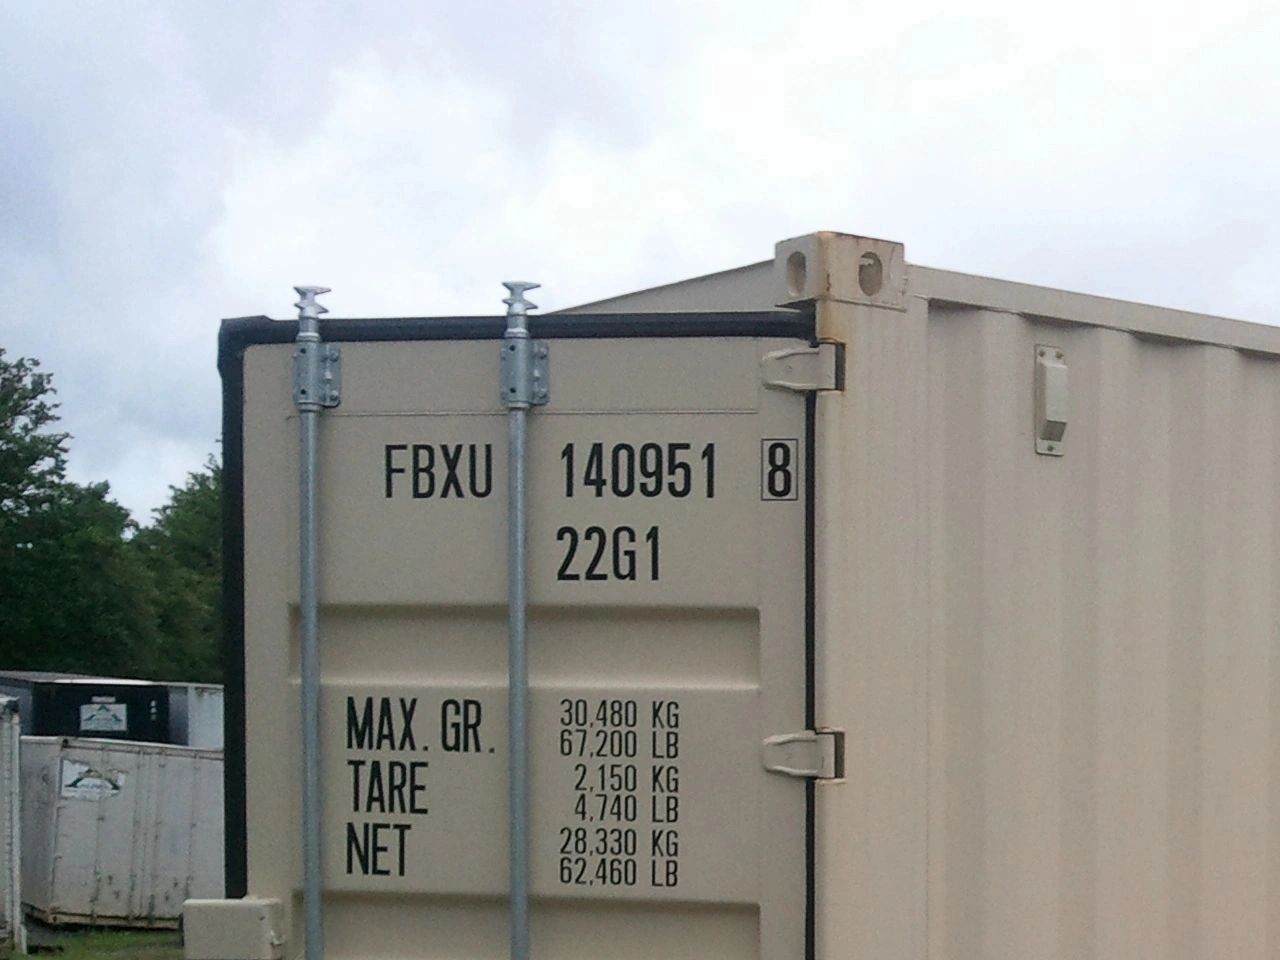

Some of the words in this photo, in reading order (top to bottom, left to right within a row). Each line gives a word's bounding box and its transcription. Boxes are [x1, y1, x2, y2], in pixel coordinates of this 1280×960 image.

[385, 444, 493, 499] FBXU
[560, 442, 715, 499] 140951
[768, 443, 791, 497] 8
[557, 526, 660, 581] 22G1
[560, 699, 637, 727] 30,480
[652, 701, 679, 728] KG
[560, 730, 637, 758] 67,200
[652, 731, 679, 759] LB
[348, 760, 428, 814] TARE
[574, 764, 637, 792] 2,150
[652, 765, 679, 792] KG
[574, 794, 637, 823] 4,740
[652, 796, 679, 823] LB
[346, 822, 411, 876] NET
[560, 827, 637, 857] 28,330
[652, 829, 679, 857] KG
[560, 859, 637, 887] 62,460
[652, 860, 679, 887] LB
